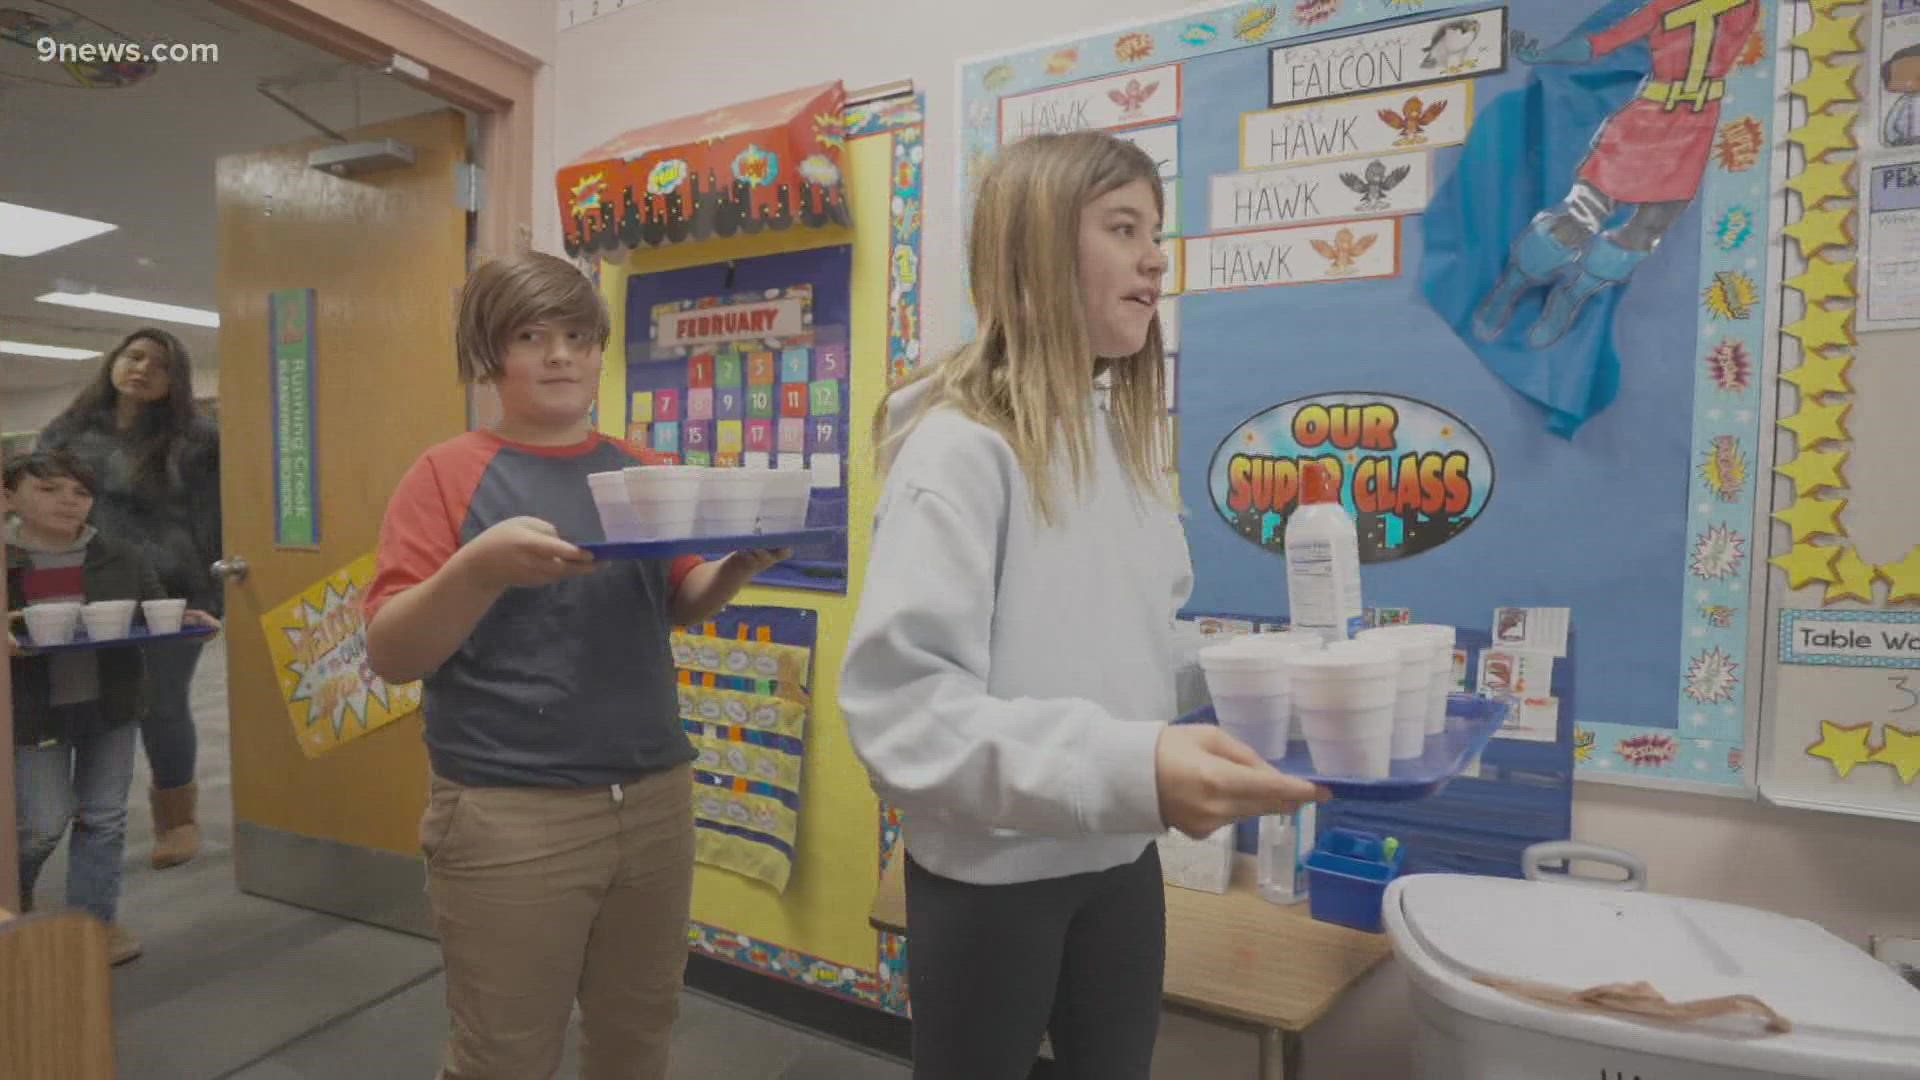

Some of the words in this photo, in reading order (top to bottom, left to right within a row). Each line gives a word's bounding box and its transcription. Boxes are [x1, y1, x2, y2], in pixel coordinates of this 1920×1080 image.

[1291, 47, 1403, 99] FALCON
[1017, 98, 1090, 138] HAWK
[1270, 115, 1359, 163] HAWK
[1234, 181, 1321, 224] HAWK
[1209, 243, 1293, 287] HAWK
[675, 308, 779, 339] FEBRUARY
[696, 363, 703, 380] 1
[823, 353, 836, 371] 5
[660, 396, 672, 412] 7
[723, 393, 733, 410] 9
[751, 391, 768, 409] 10
[787, 389, 800, 408] 11
[688, 426, 703, 443] 15
[816, 424, 832, 444] 19
[1290, 402, 1399, 451] OUR
[1228, 452, 1343, 514] SUPR
[1353, 450, 1473, 516] CLASS
[1800, 626, 1872, 649] Table
